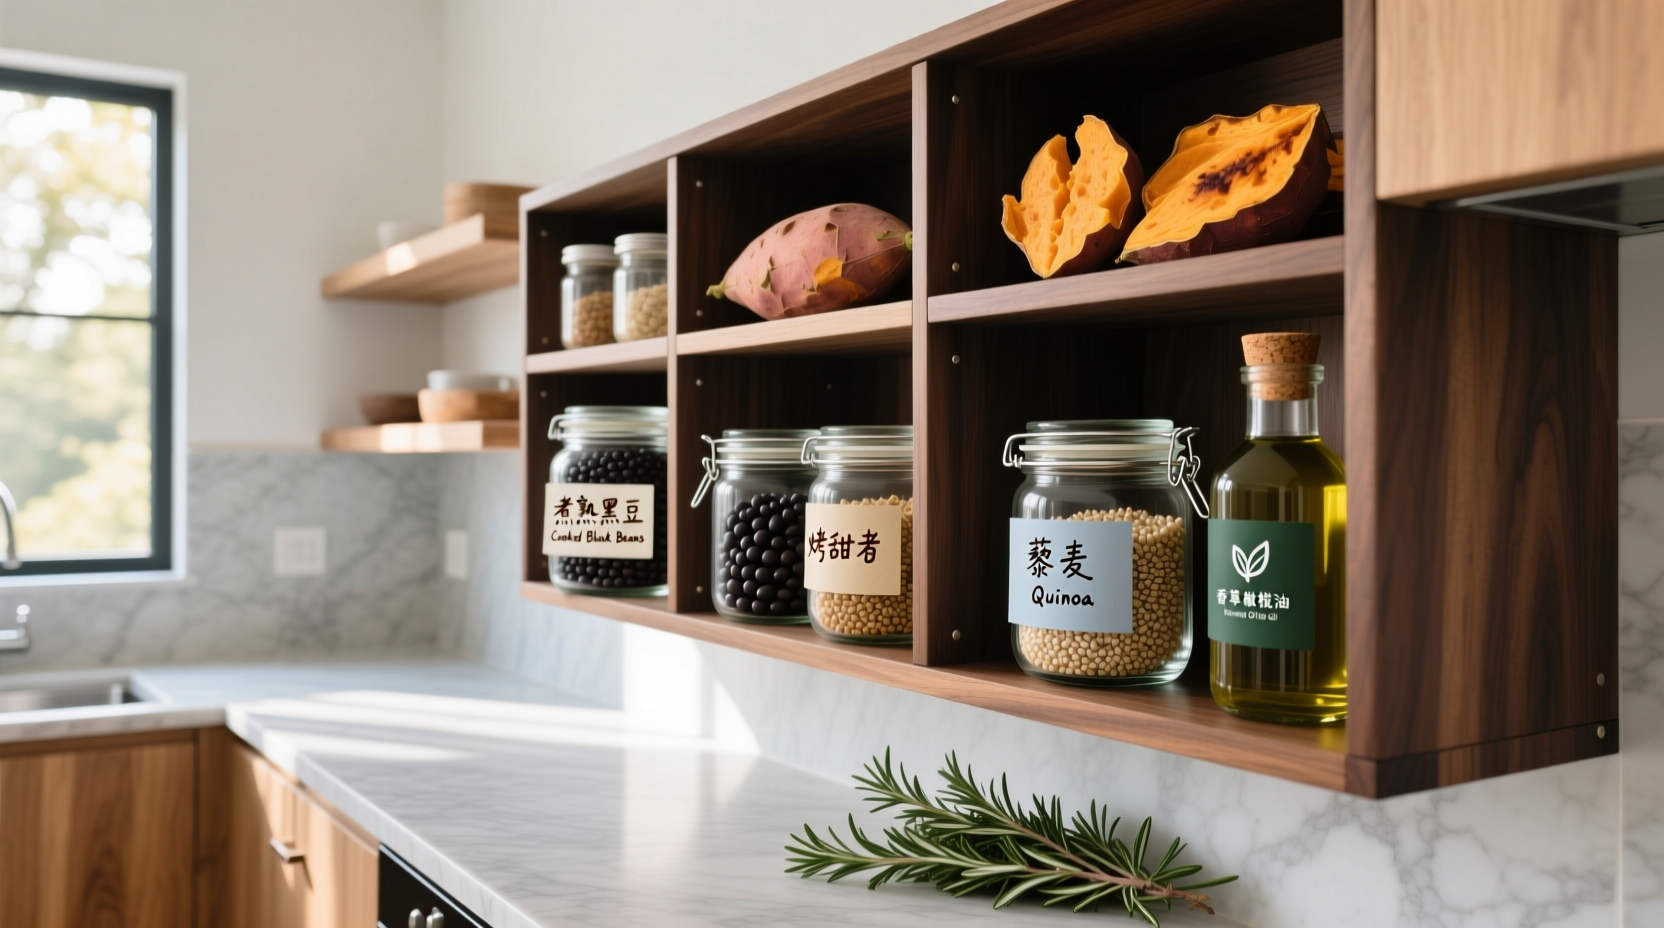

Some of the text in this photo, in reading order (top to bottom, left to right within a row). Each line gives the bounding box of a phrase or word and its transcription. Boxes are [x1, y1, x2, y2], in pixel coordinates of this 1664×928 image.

[554, 495, 643, 525] 煮熟黑豆
[616, 531, 644, 543] Beans
[808, 527, 881, 563] 烤甜者
[1027, 537, 1093, 580] 藜麦
[1032, 585, 1094, 607] Quinoa
